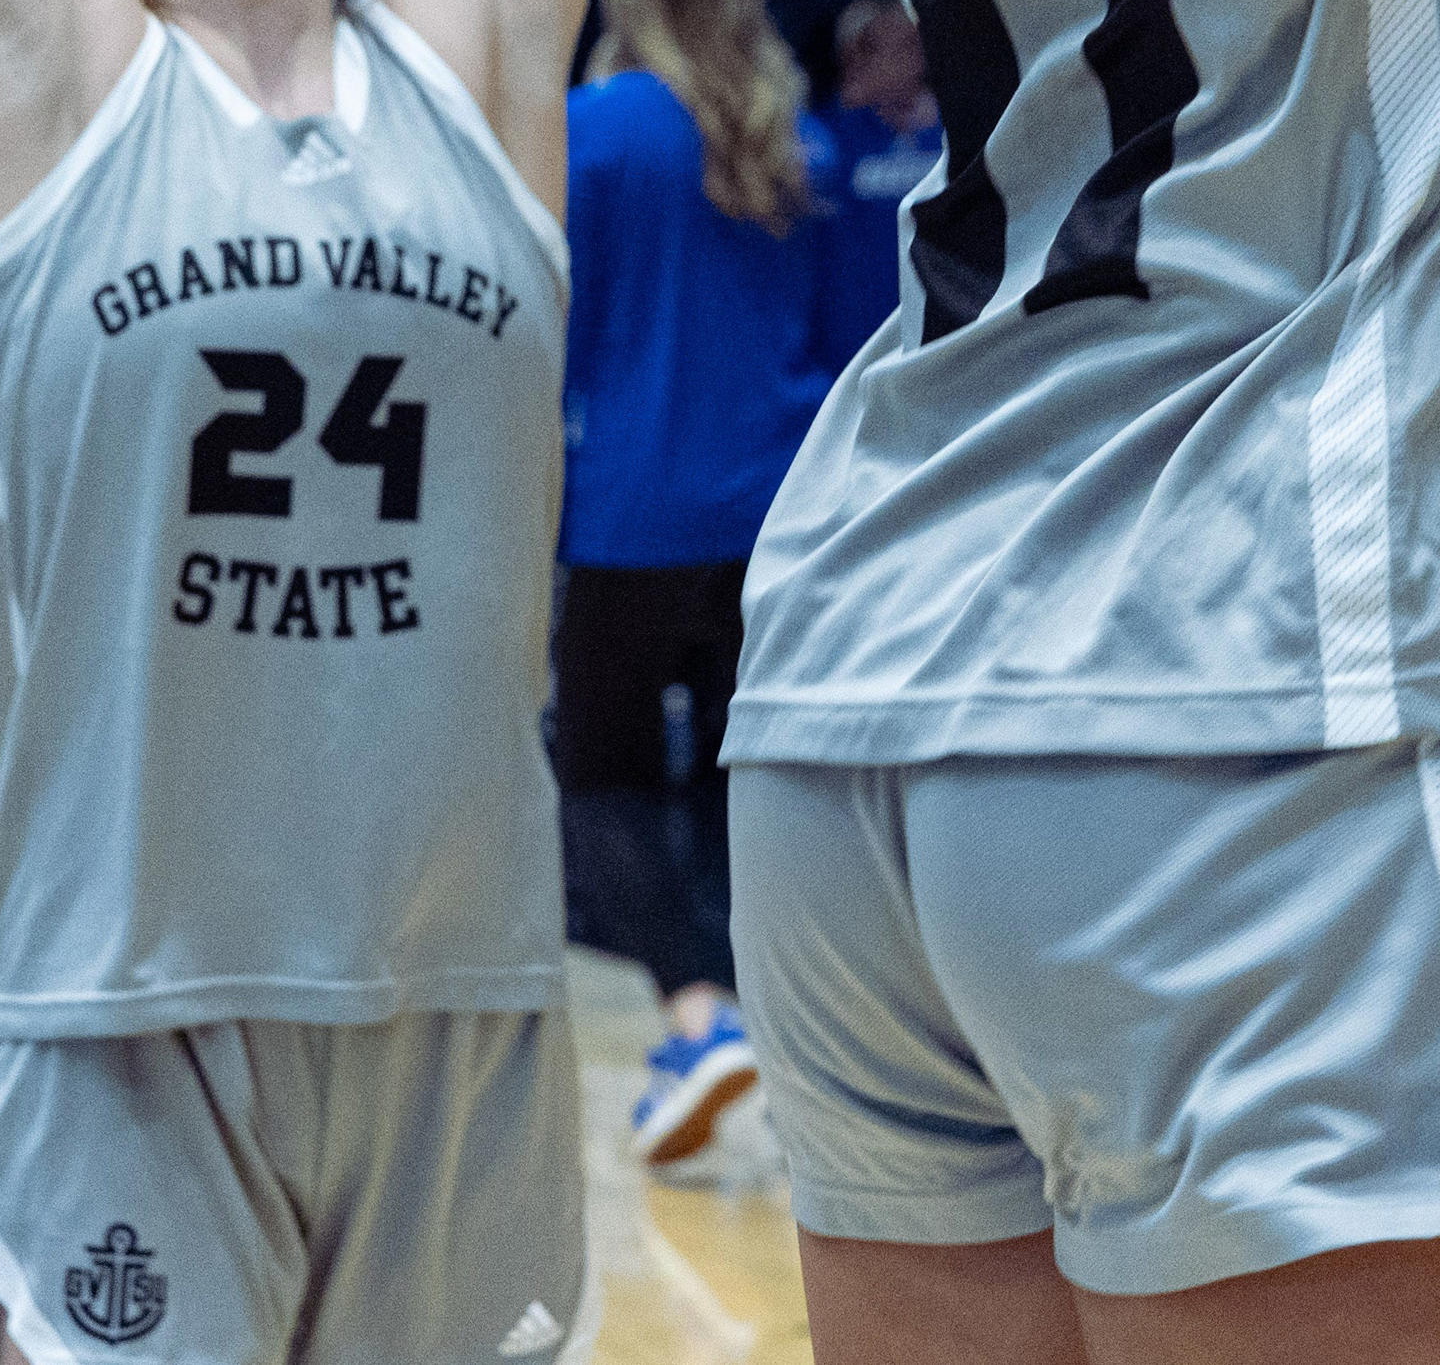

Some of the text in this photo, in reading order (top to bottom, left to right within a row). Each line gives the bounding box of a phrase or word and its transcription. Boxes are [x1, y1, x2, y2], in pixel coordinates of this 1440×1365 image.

[91, 235, 520, 339] GRAND VALLEY
[187, 347, 428, 523] 24
[172, 552, 420, 640] STATE
